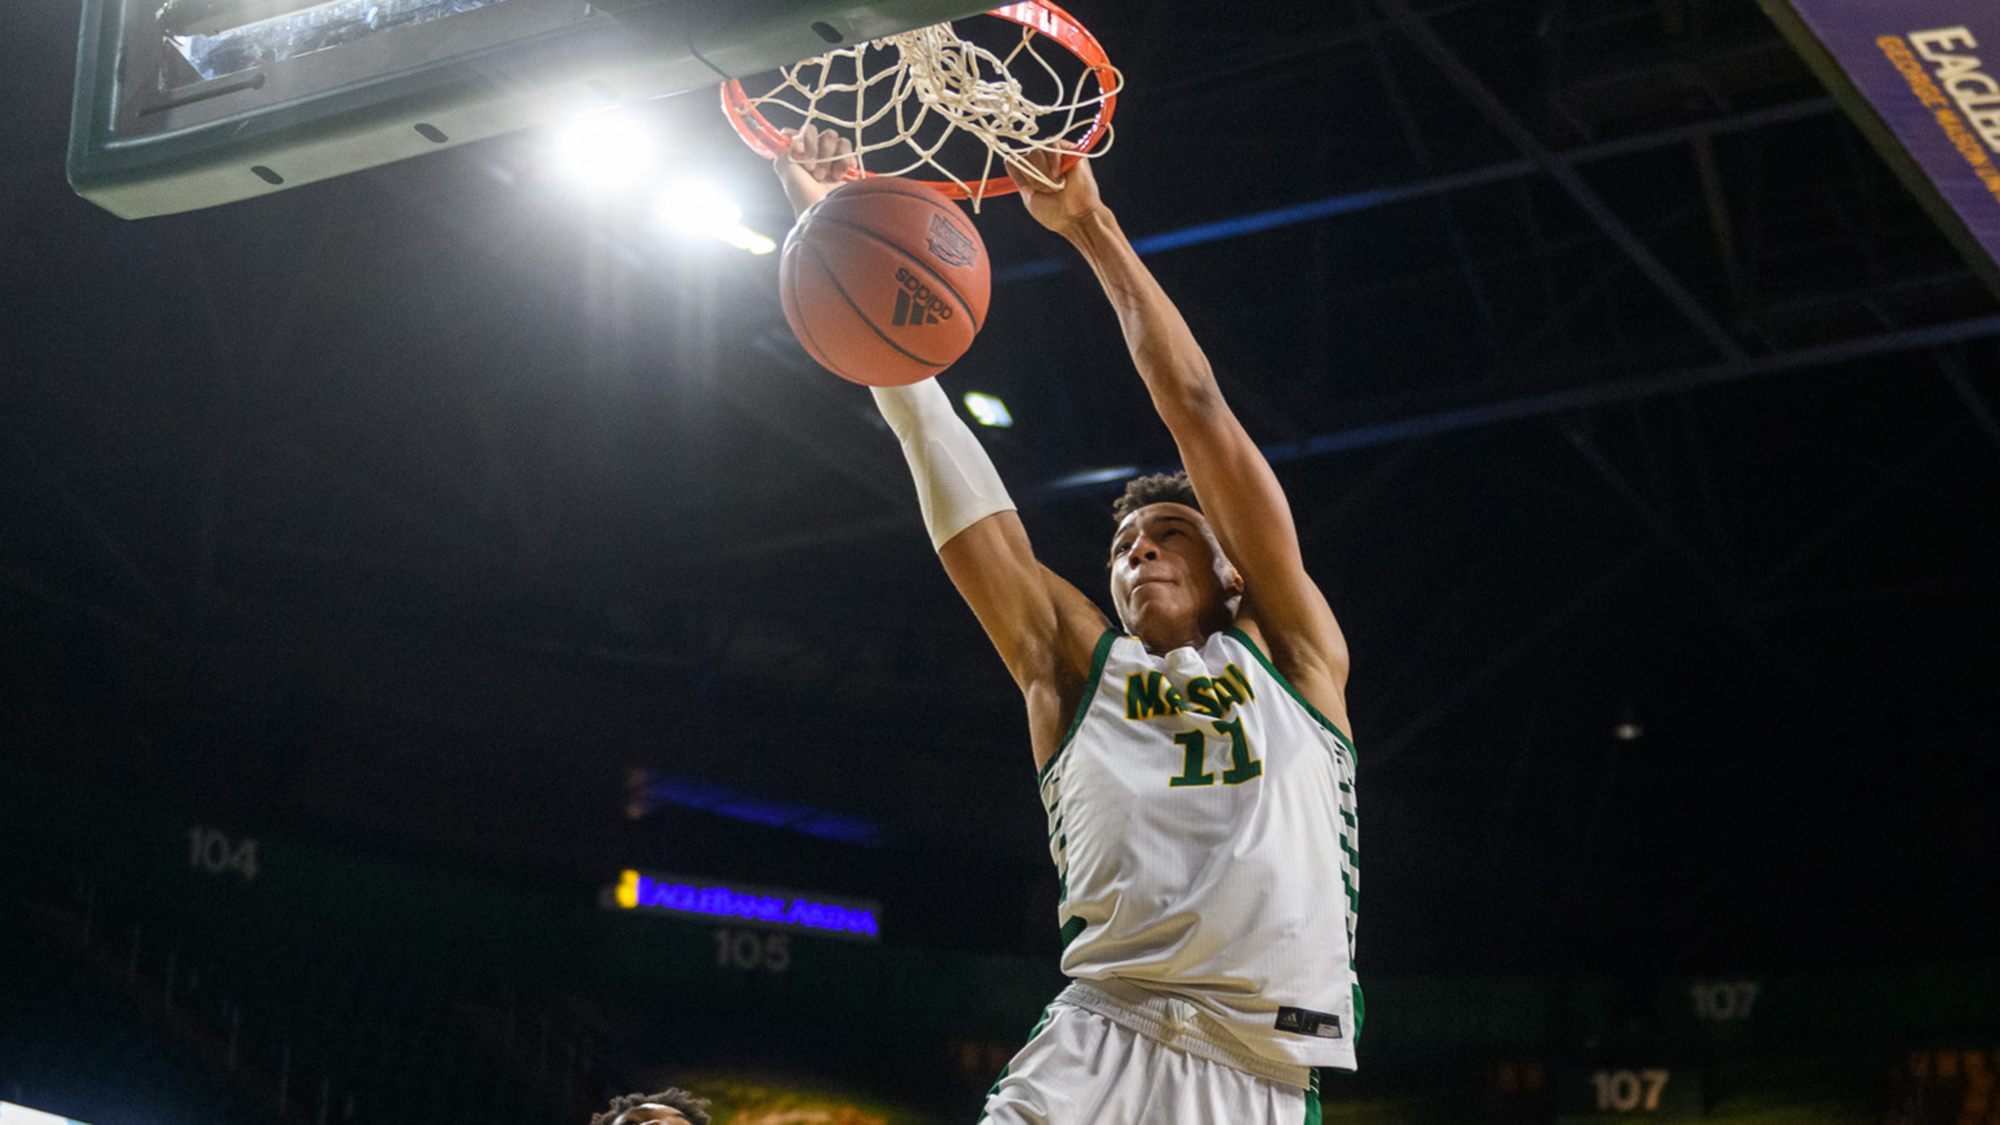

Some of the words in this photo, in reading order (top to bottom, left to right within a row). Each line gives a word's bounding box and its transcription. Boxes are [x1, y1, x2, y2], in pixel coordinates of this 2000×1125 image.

[1907, 26, 2000, 153] EAGLE
[895, 267, 953, 320] adidas
[1169, 715, 1263, 787] 11
[189, 826, 259, 880] 104
[716, 928, 790, 973] 105
[1691, 979, 1760, 1021] 107
[1592, 1068, 1671, 1112] 107
